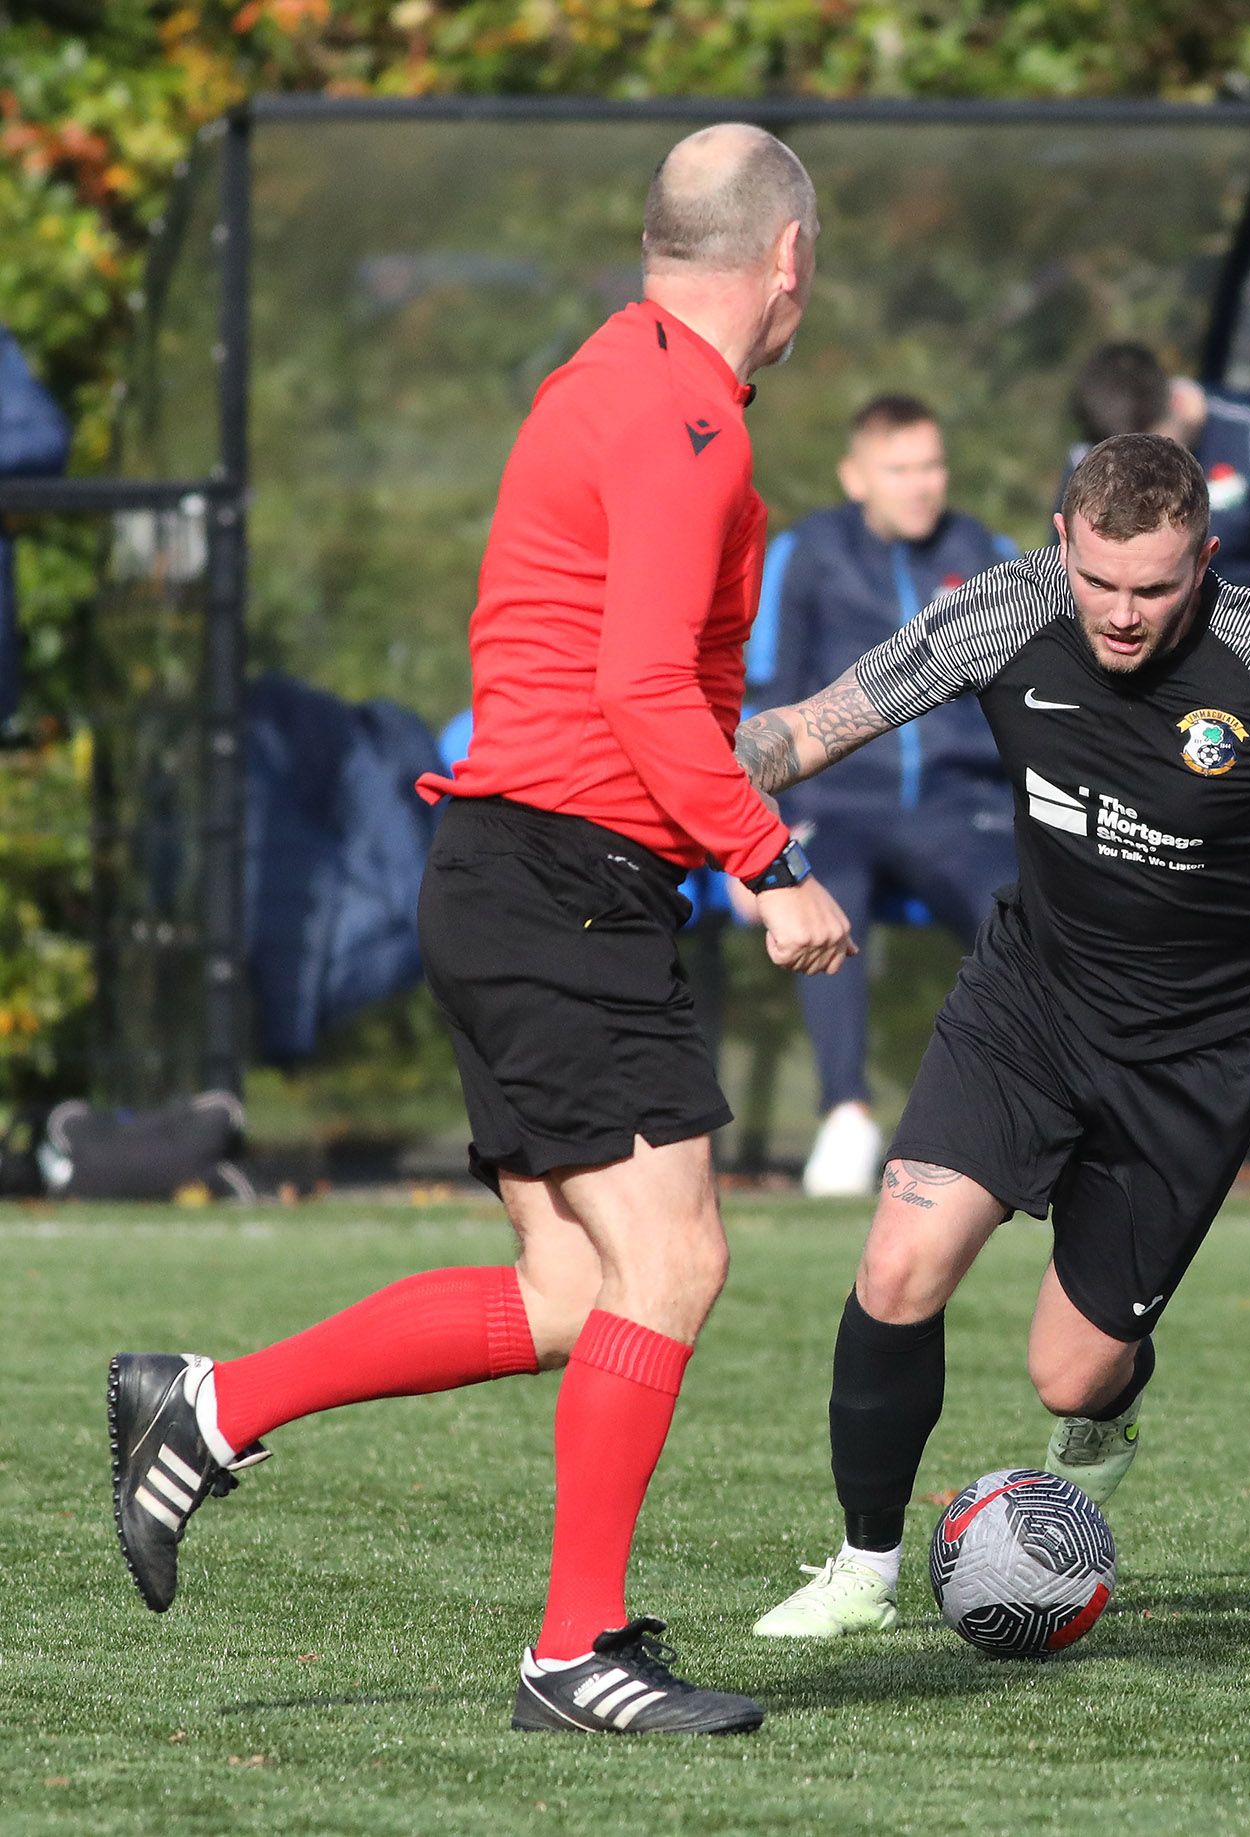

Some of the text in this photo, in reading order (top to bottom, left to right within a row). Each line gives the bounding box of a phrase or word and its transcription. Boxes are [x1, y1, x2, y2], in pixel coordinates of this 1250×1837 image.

[1188, 710, 1240, 728] IMMACULATA
[1098, 793, 1138, 820] The
[1097, 808, 1204, 850] Mortgage
[1097, 843, 1119, 857] You
[1148, 855, 1167, 867] We
